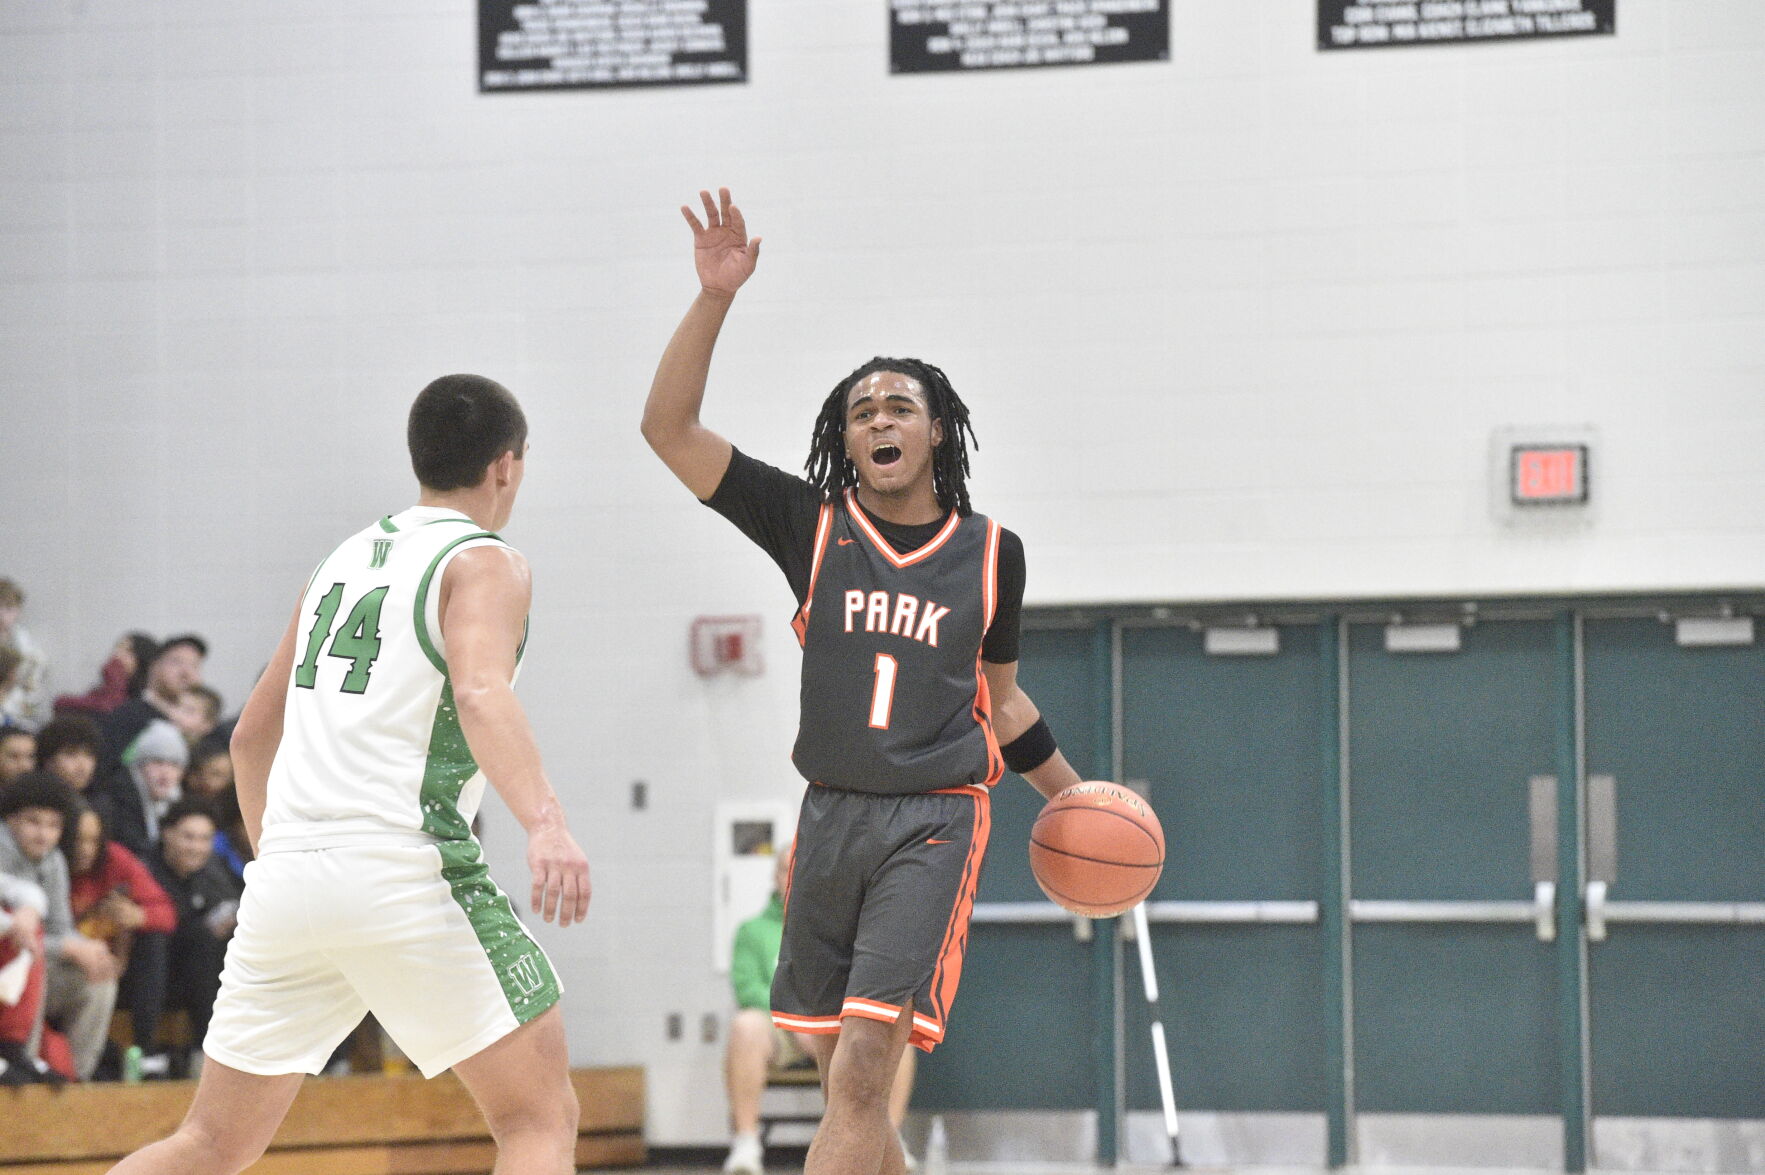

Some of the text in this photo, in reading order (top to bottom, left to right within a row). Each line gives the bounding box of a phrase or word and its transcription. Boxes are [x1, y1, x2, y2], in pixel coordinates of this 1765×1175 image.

[369, 539, 394, 570] W
[296, 582, 390, 695] 14
[844, 589, 951, 648] PARK
[868, 652, 898, 730] 1
[507, 952, 544, 996] W
